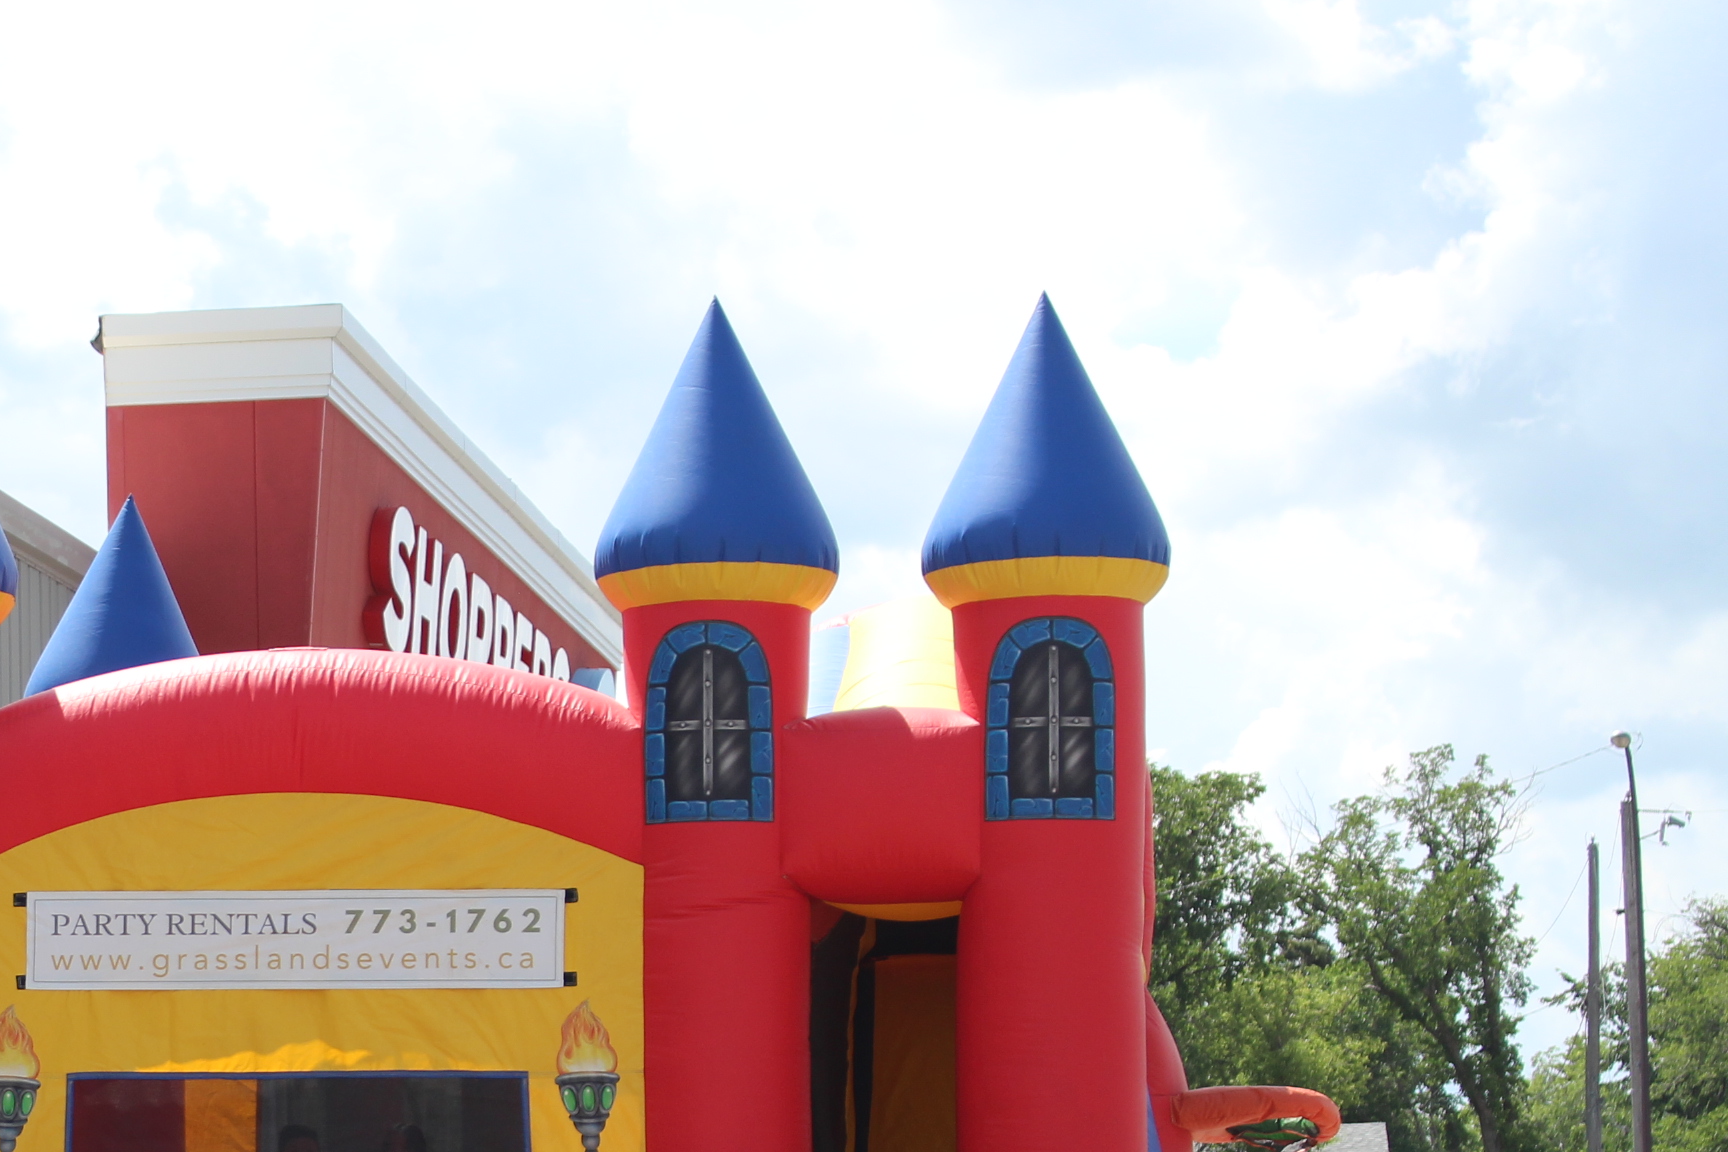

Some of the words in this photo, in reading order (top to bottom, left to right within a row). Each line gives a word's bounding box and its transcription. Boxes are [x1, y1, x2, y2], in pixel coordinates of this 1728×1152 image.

[383, 505, 570, 683] SHOPP
[51, 913, 157, 936] PARTY
[166, 912, 318, 936] RENTALS
[345, 907, 541, 935] 773-1762
[50, 944, 535, 978] www.grasslandsevents.ca
